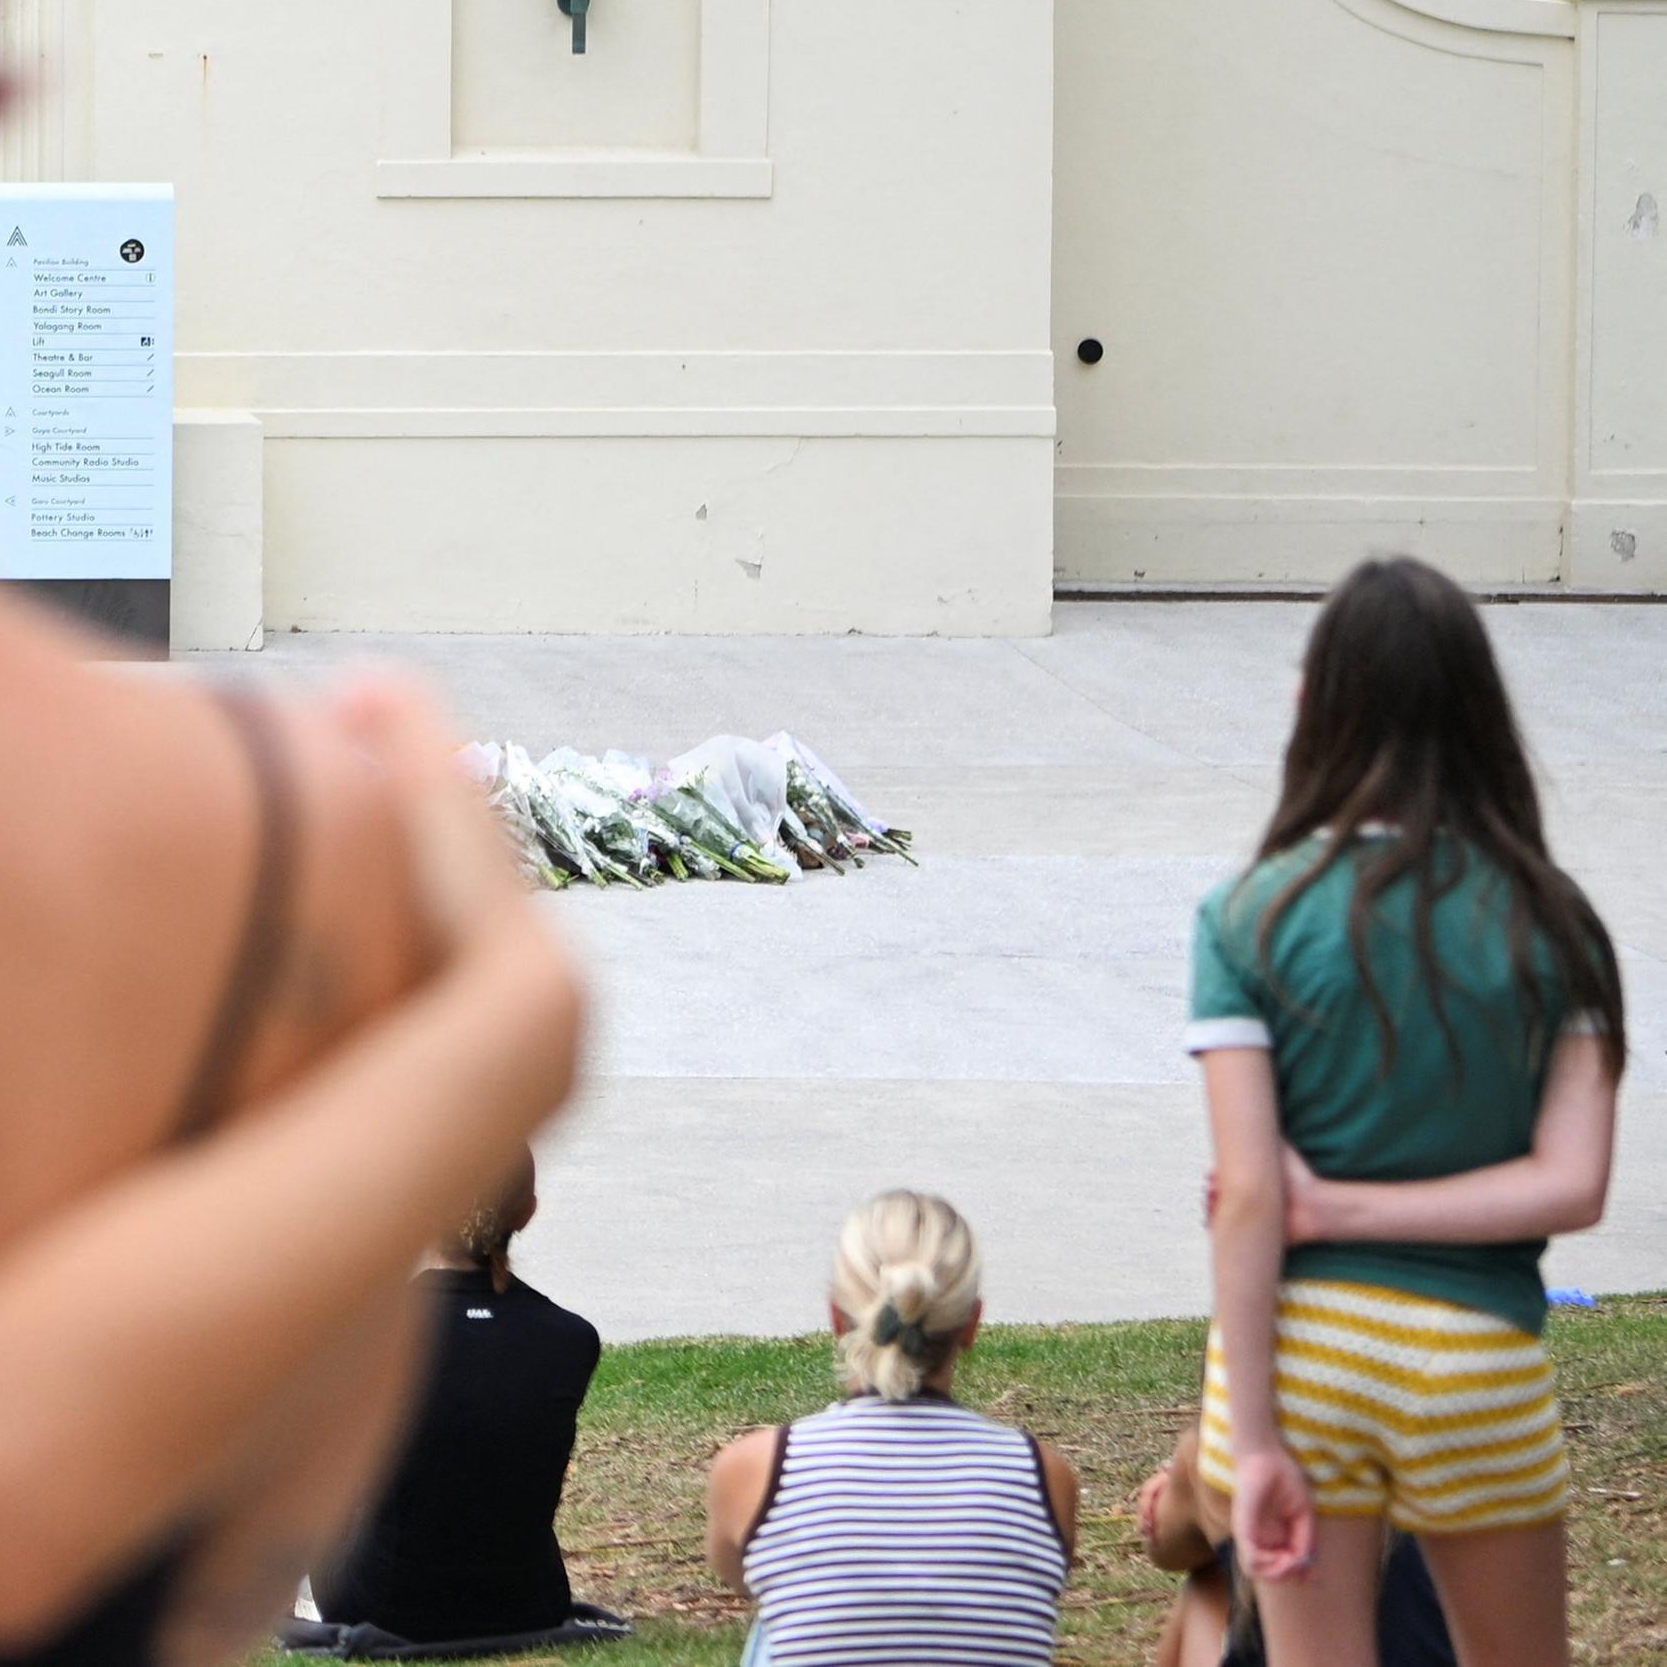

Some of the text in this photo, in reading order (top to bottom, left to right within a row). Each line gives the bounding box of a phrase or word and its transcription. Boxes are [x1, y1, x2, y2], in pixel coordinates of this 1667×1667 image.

[62, 258, 89, 267] Building
[34, 273, 107, 283] Welcome Centre
[34, 288, 83, 300] Art Gallery
[33, 305, 112, 317] Bondi Story Room
[77, 321, 103, 331] Room
[32, 337, 45, 347] Lift
[33, 353, 94, 362] Theatre & Bar
[33, 368, 92, 380] Seagull Room
[32, 384, 90, 394] Ocean Room
[52, 427, 87, 435] Courtyard
[31, 443, 101, 454] High Tide Room
[31, 458, 140, 468] Community Radio Studio
[32, 474, 91, 484] Music Studios
[51, 497, 86, 506] Courtyard
[31, 513, 96, 524] Pottery Studio
[31, 528, 126, 540] Beach Change Rooms
